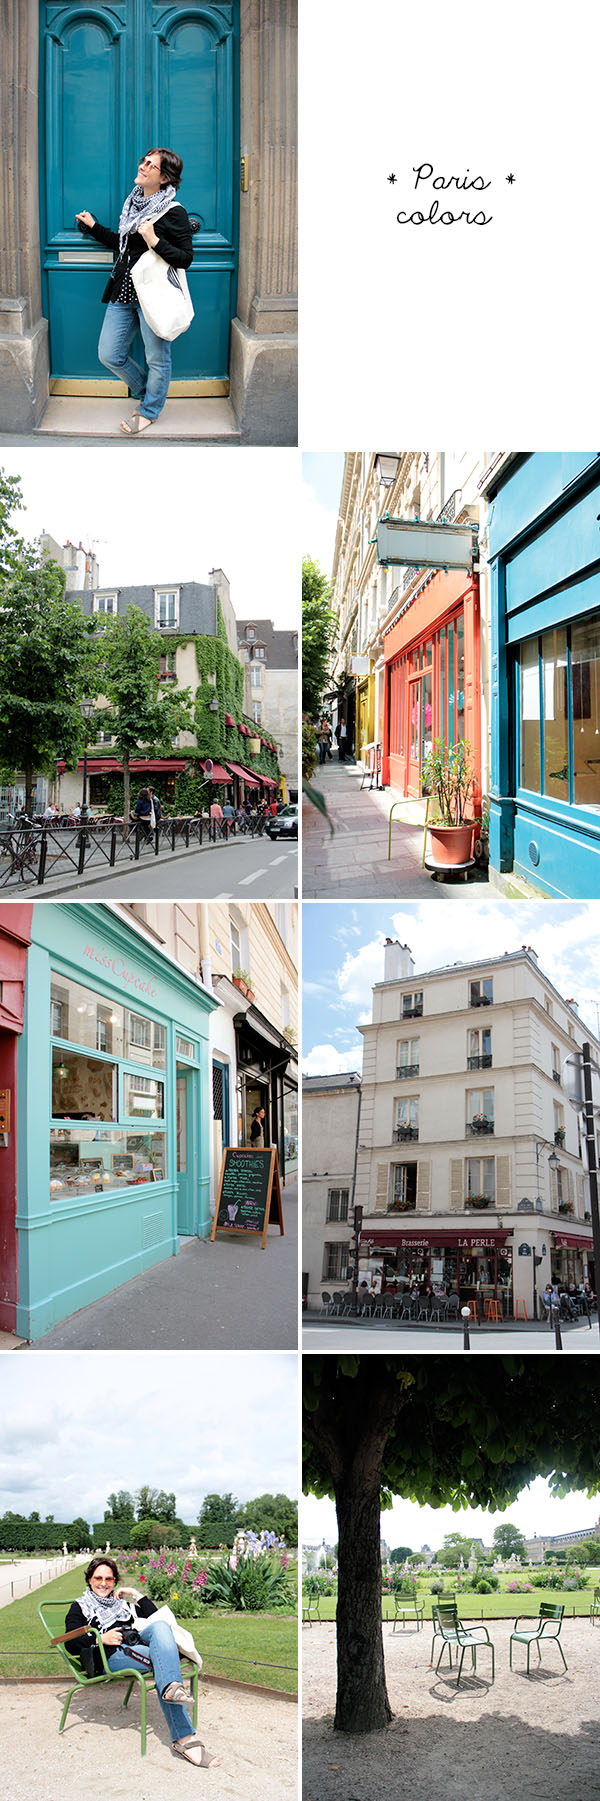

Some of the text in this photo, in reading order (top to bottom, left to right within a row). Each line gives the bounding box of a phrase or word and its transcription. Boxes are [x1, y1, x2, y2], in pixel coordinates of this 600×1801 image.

[401, 1238, 429, 1247] Brasserie
[458, 1238, 468, 1247] LA
[470, 1238, 496, 1247] PERLE
